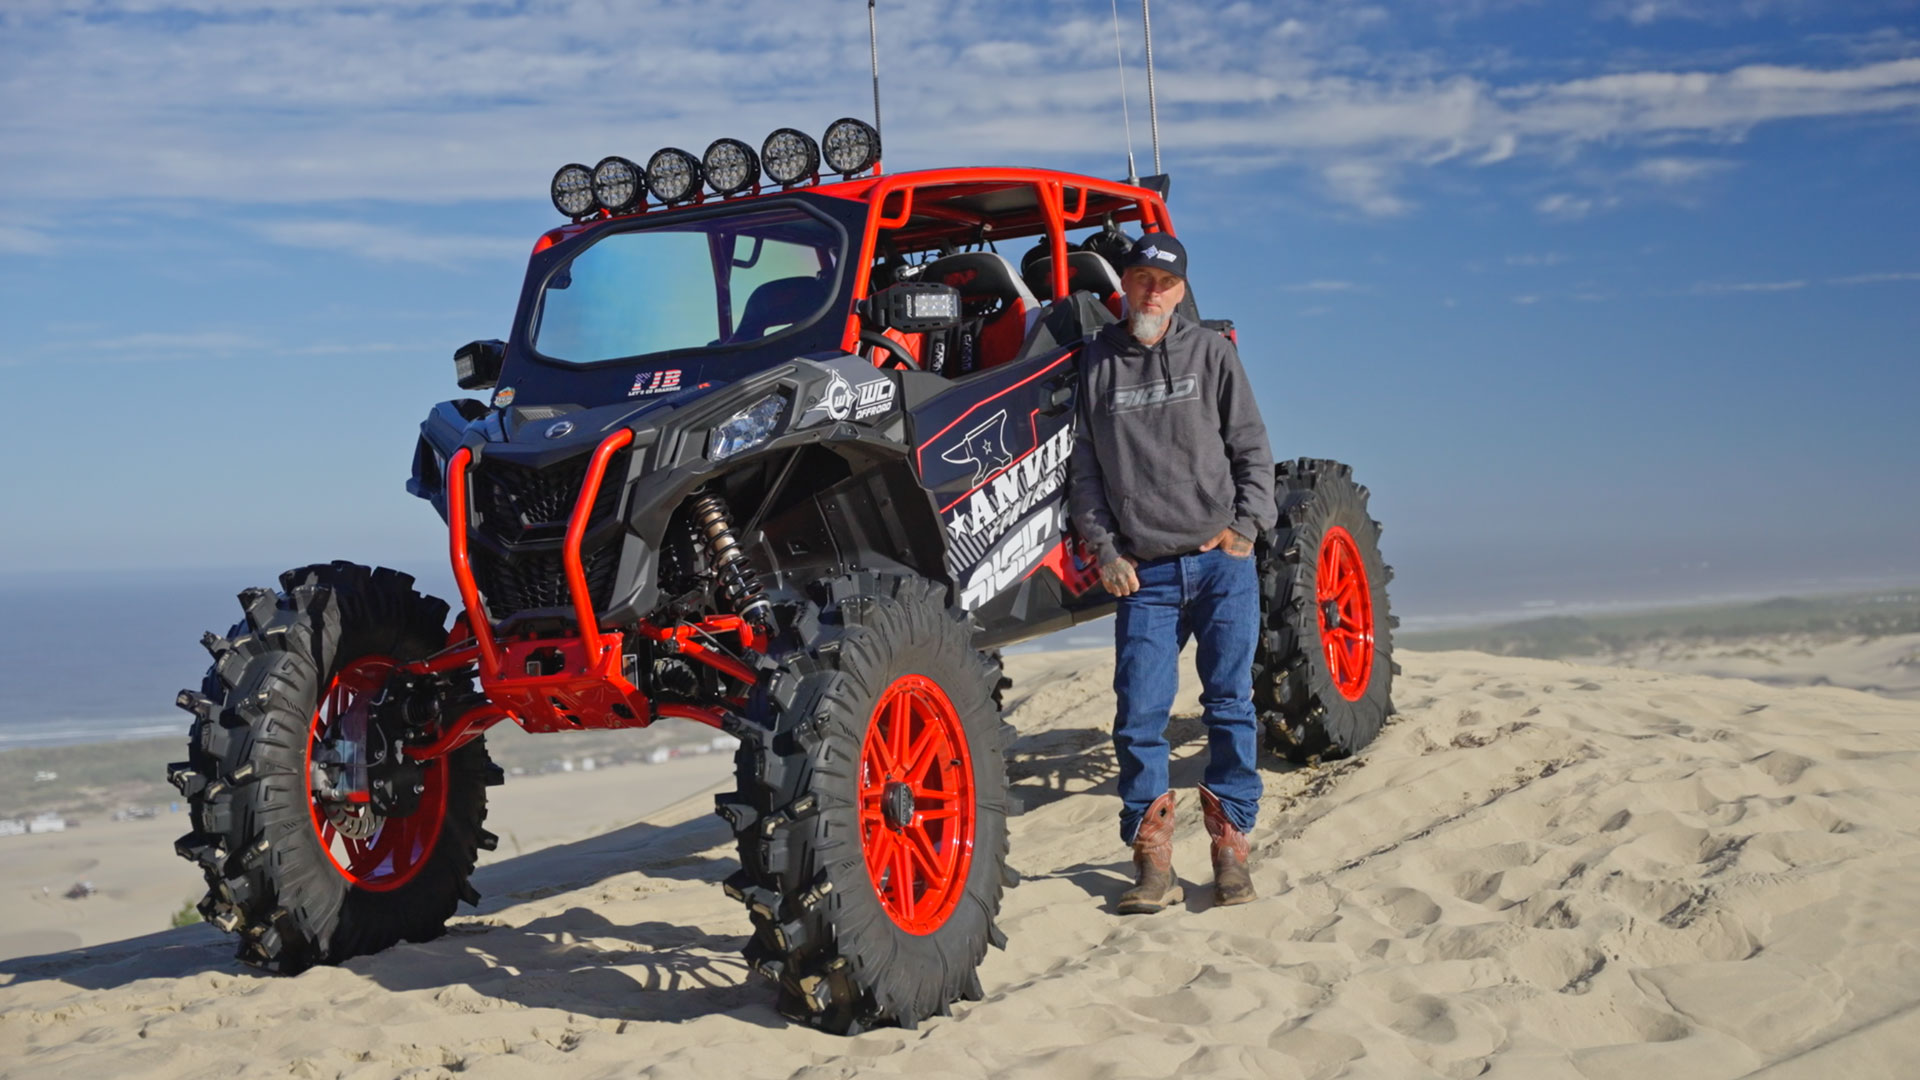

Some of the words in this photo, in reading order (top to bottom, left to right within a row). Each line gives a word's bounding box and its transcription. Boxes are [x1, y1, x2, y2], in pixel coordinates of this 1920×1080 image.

[631, 369, 682, 391] FJB
[1109, 379, 1195, 411] RIGD
[856, 402, 892, 420] OFFROAD
[970, 424, 1073, 537] ANVIL
